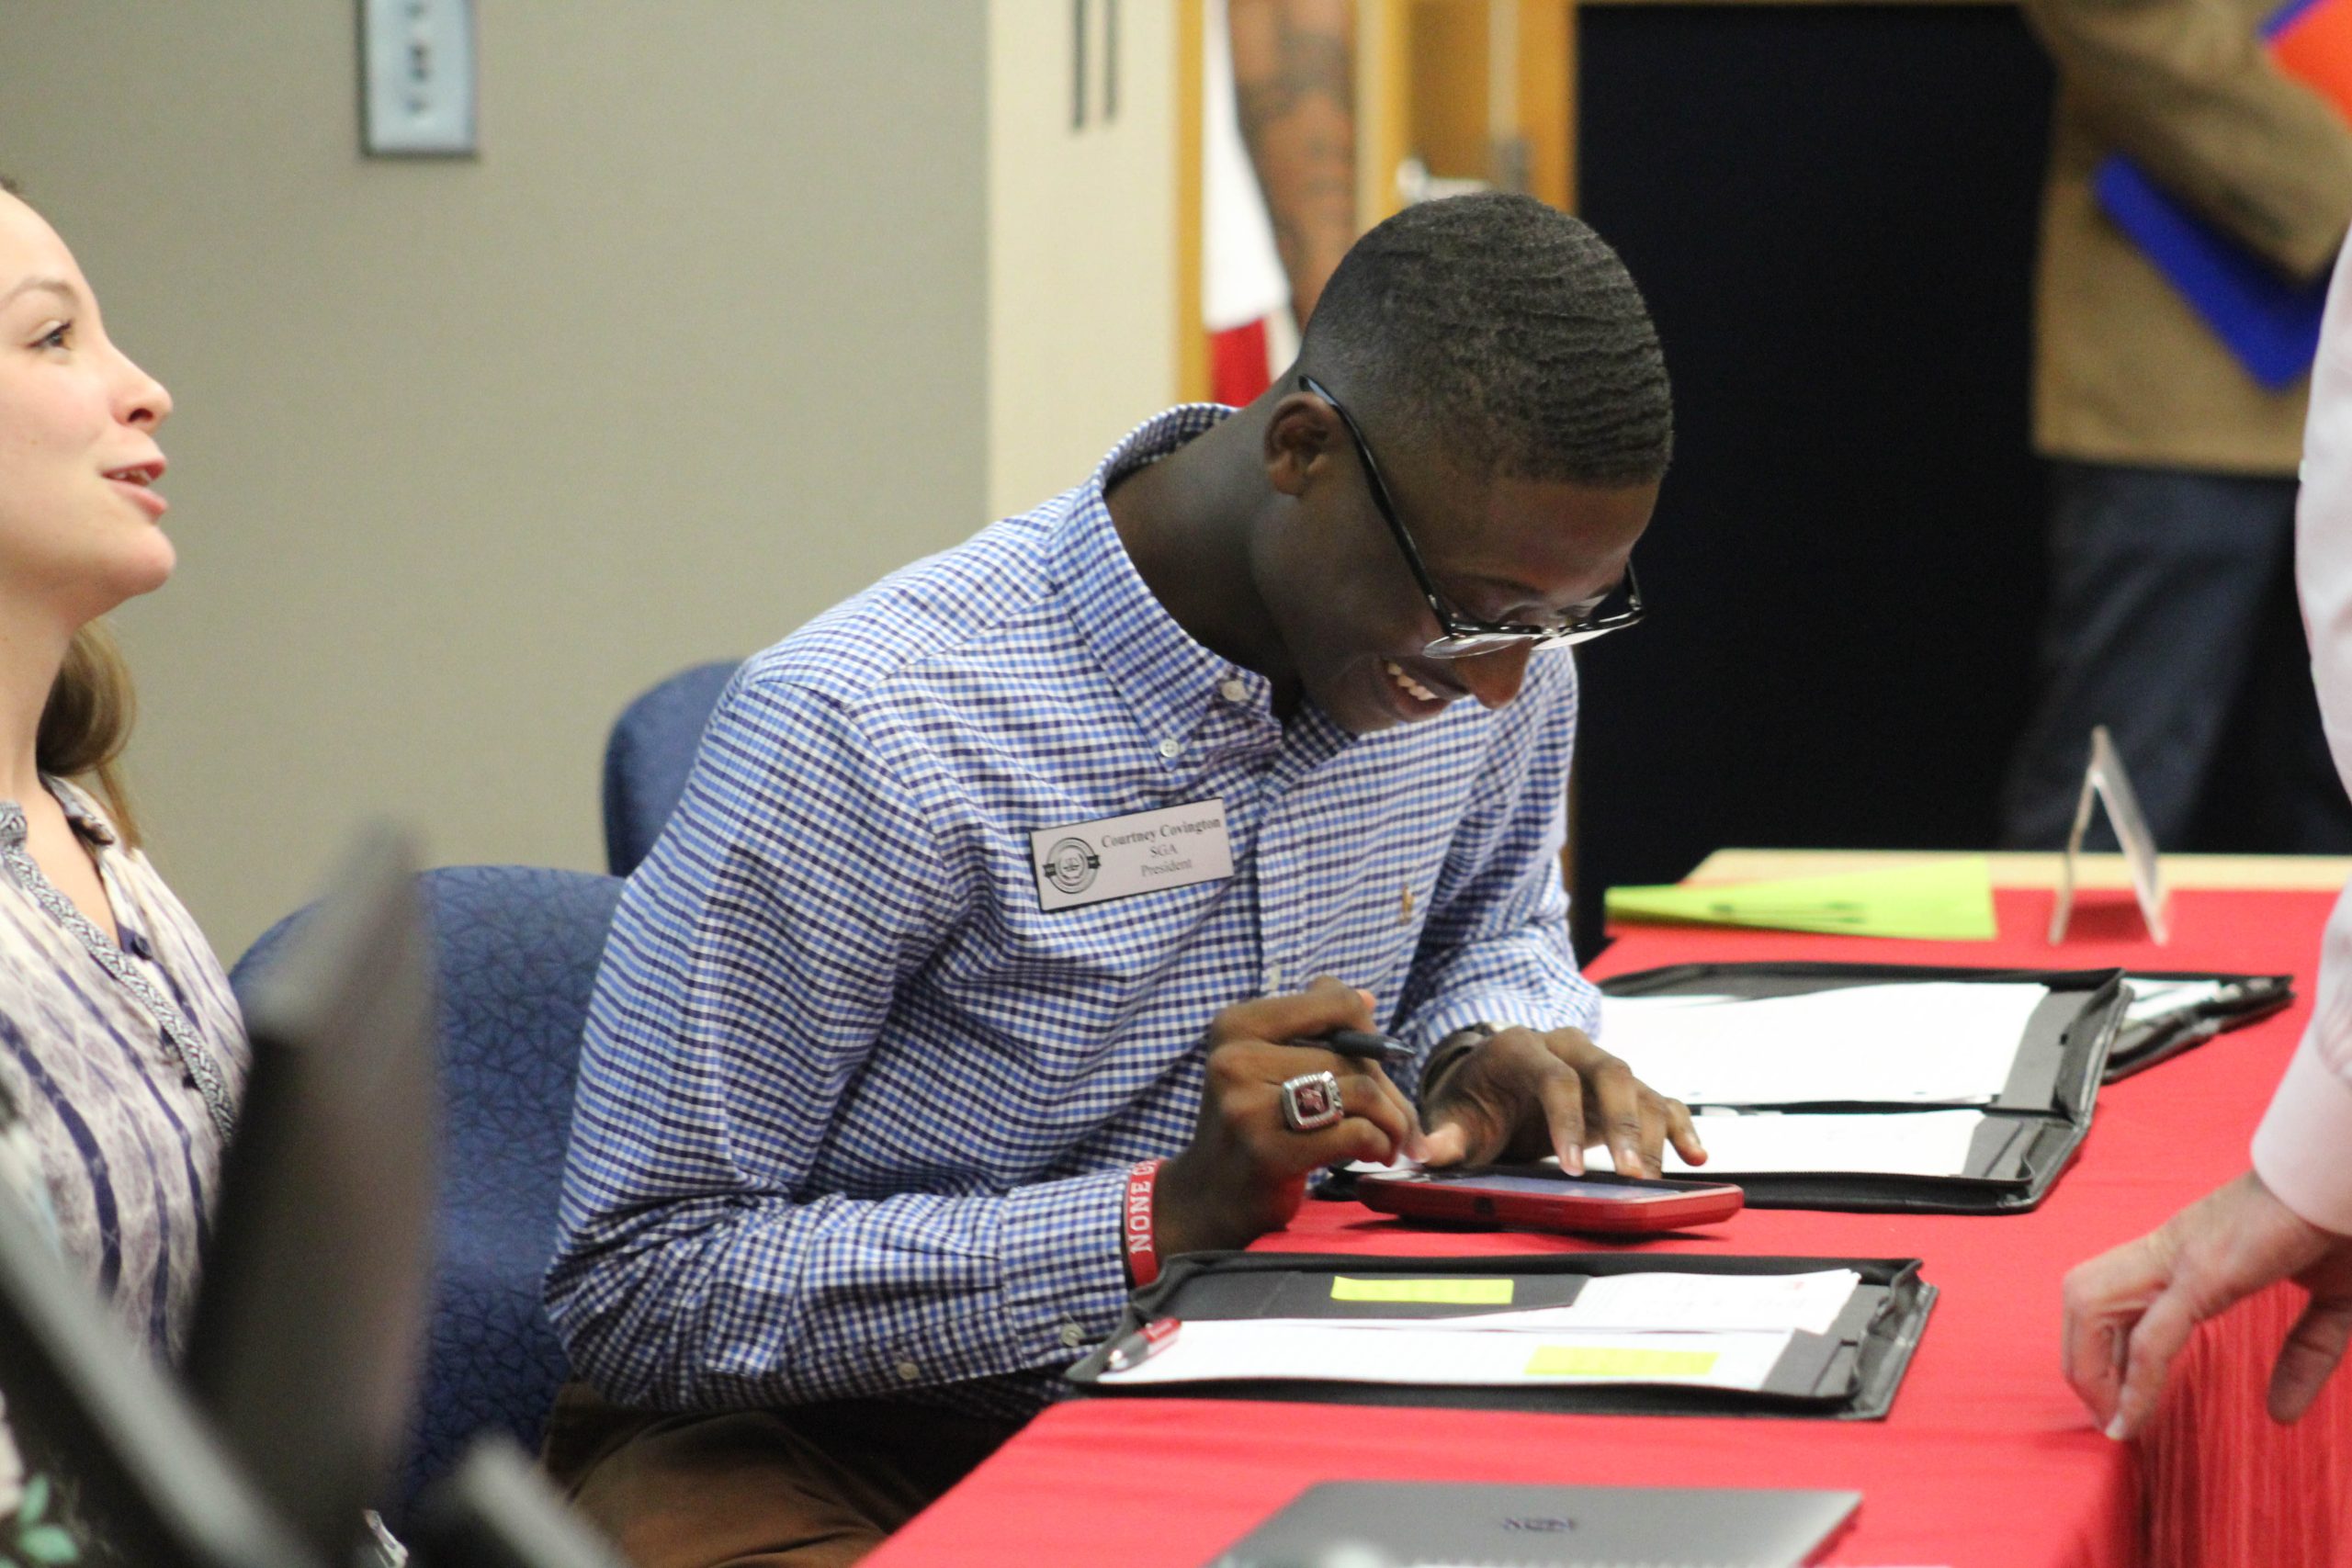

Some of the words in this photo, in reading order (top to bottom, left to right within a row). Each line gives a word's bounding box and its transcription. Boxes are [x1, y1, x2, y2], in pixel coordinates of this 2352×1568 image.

[1102, 829, 1156, 849] Courtney
[1159, 818, 1222, 838] Covington
[1149, 843, 1179, 858] SGA
[1141, 858, 1193, 877] President
[1128, 1180, 1152, 1254] NONE
